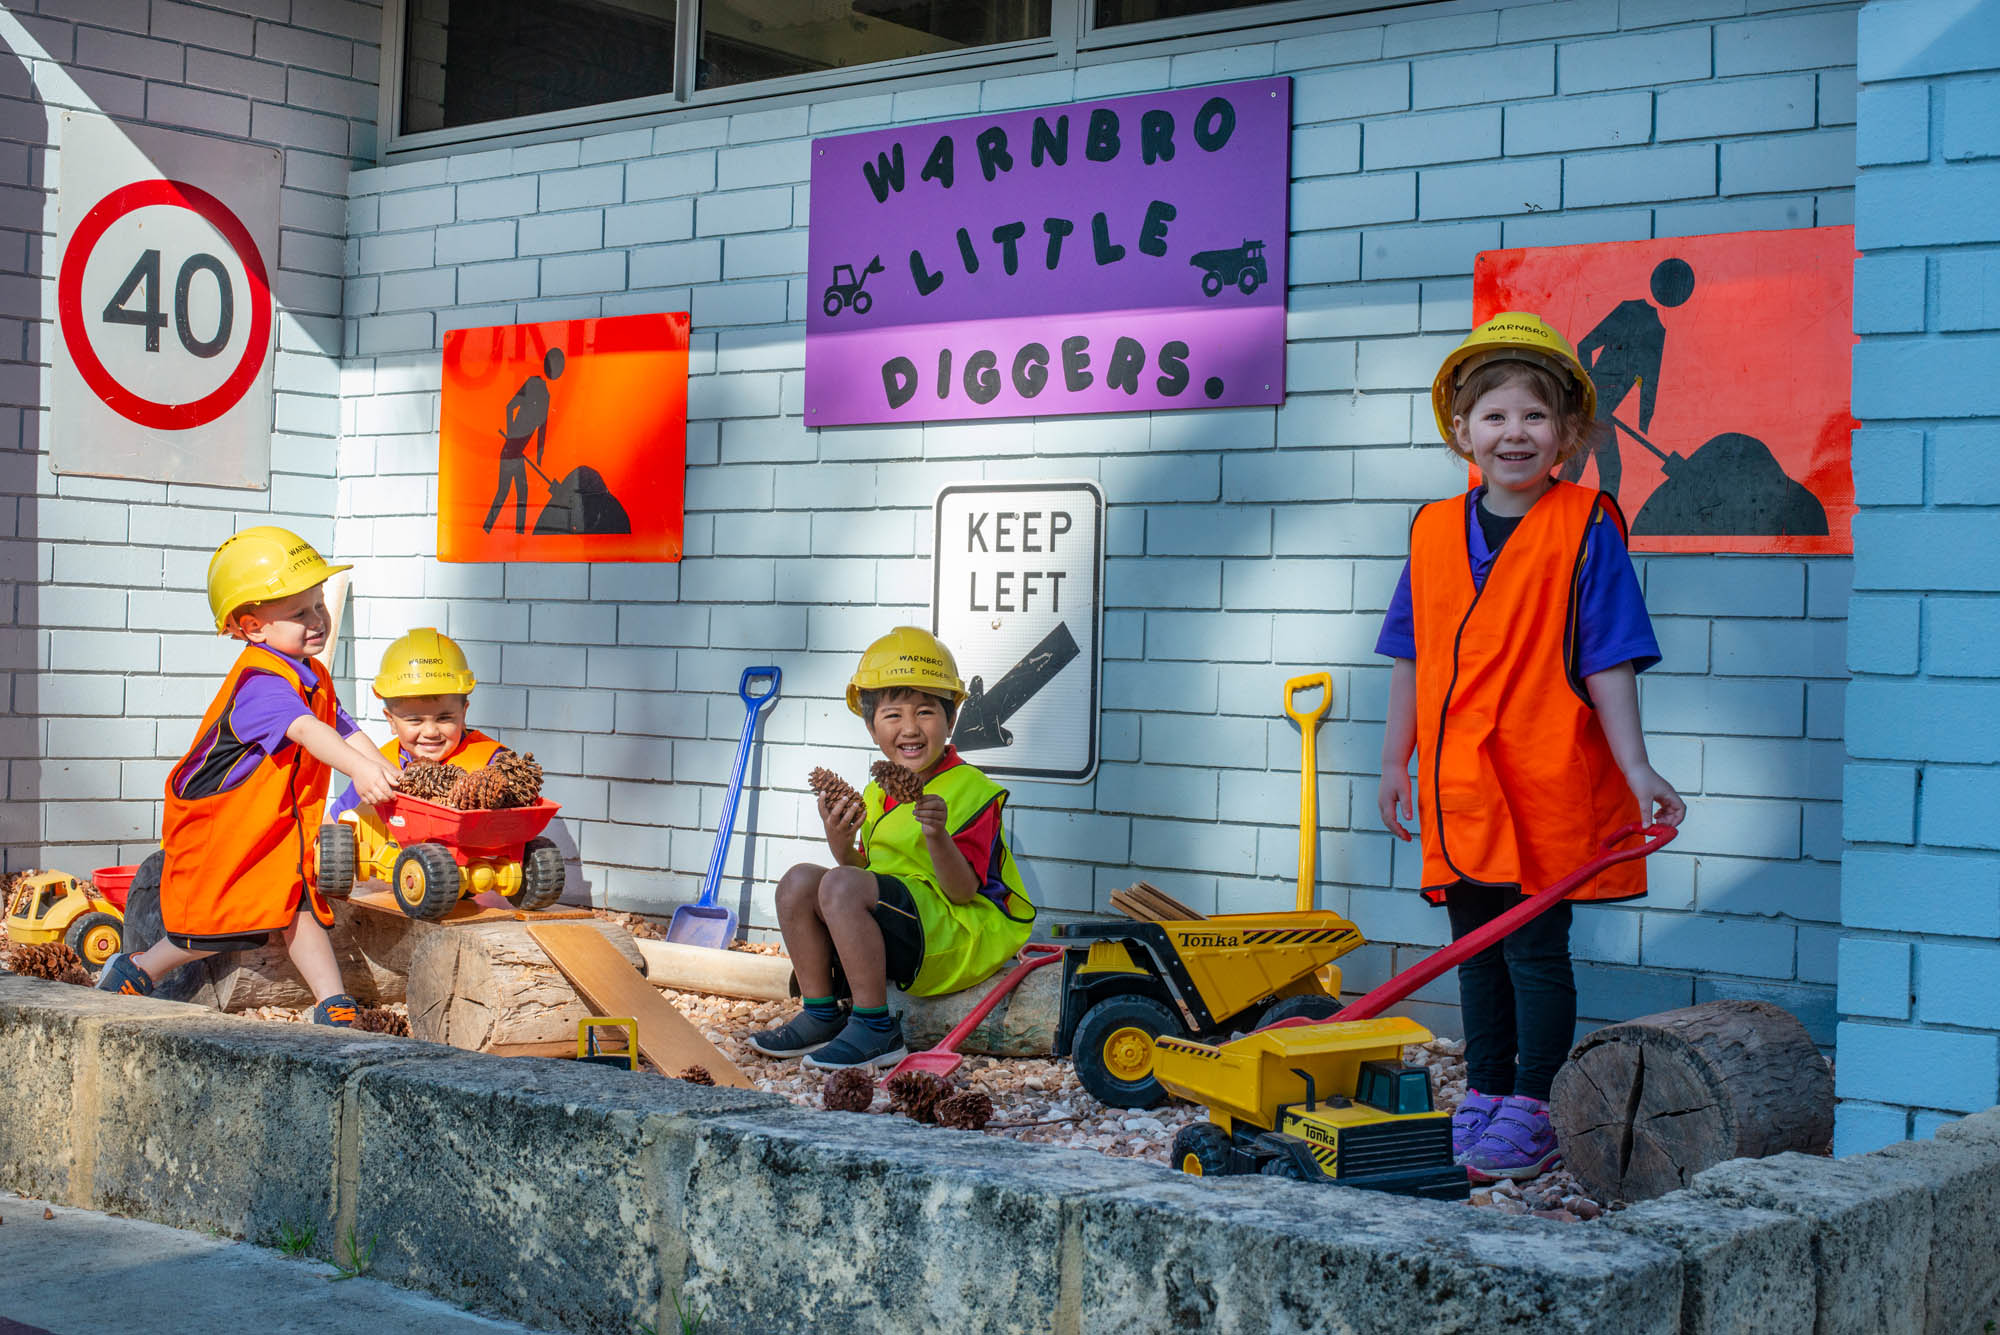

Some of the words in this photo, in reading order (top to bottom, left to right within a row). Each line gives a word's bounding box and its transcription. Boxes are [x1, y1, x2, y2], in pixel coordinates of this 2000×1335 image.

[863, 97, 1236, 203] WARNBRO
[909, 200, 1177, 296] LITTLE
[102, 248, 234, 359] 40
[1488, 323, 1549, 338] WARNBRO
[882, 335, 1224, 410] DIGGERS.
[968, 511, 1073, 553] KEEP
[969, 571, 1067, 613] LEFT
[899, 655, 944, 667] WARNBRO
[1178, 932, 1240, 947] Tonka
[1303, 1123, 1335, 1145] Tonka
